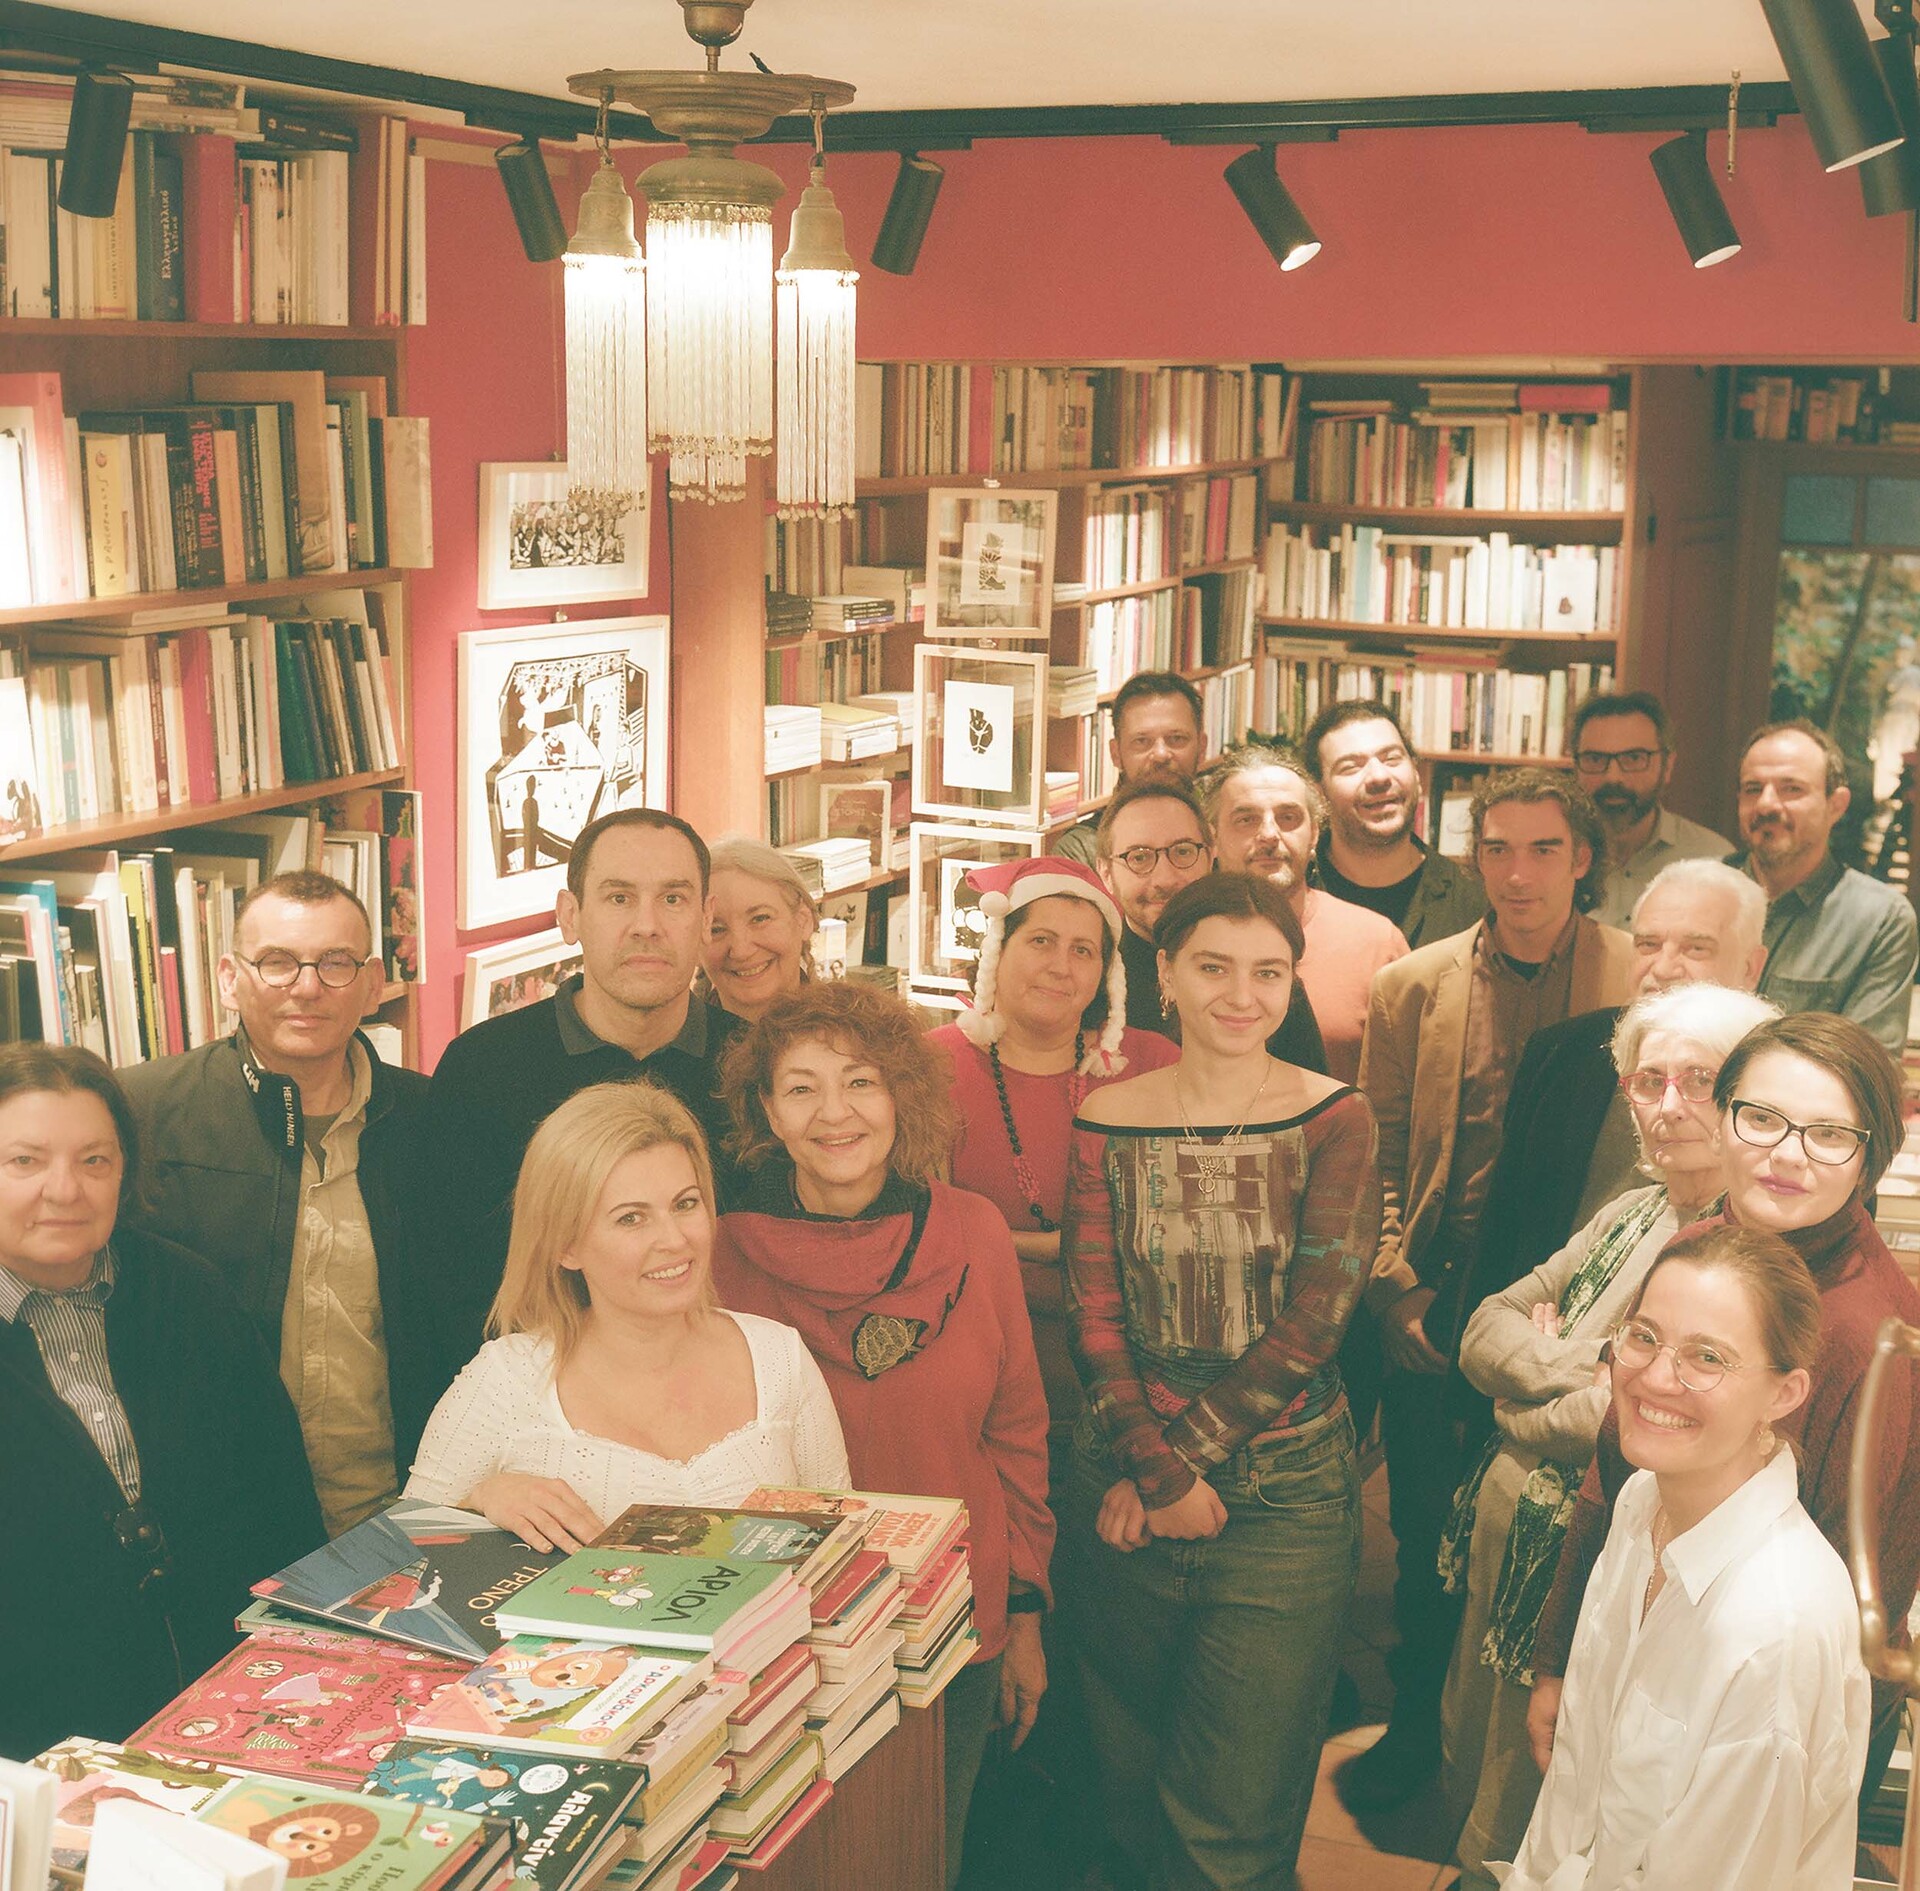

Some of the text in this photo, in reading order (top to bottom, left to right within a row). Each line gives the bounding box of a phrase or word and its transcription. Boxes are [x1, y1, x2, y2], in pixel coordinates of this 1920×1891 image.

[283, 1086, 294, 1111] HELLY
[467, 1565, 549, 1611] ΤΡΕΝΟ
[651, 1555, 740, 1622] ΑΡΙΟΛ
[307, 1676, 405, 1754] Καρυοθραύστης
[521, 1790, 593, 1867] Αλαντίν
[336, 1863, 372, 1891] κύρι
